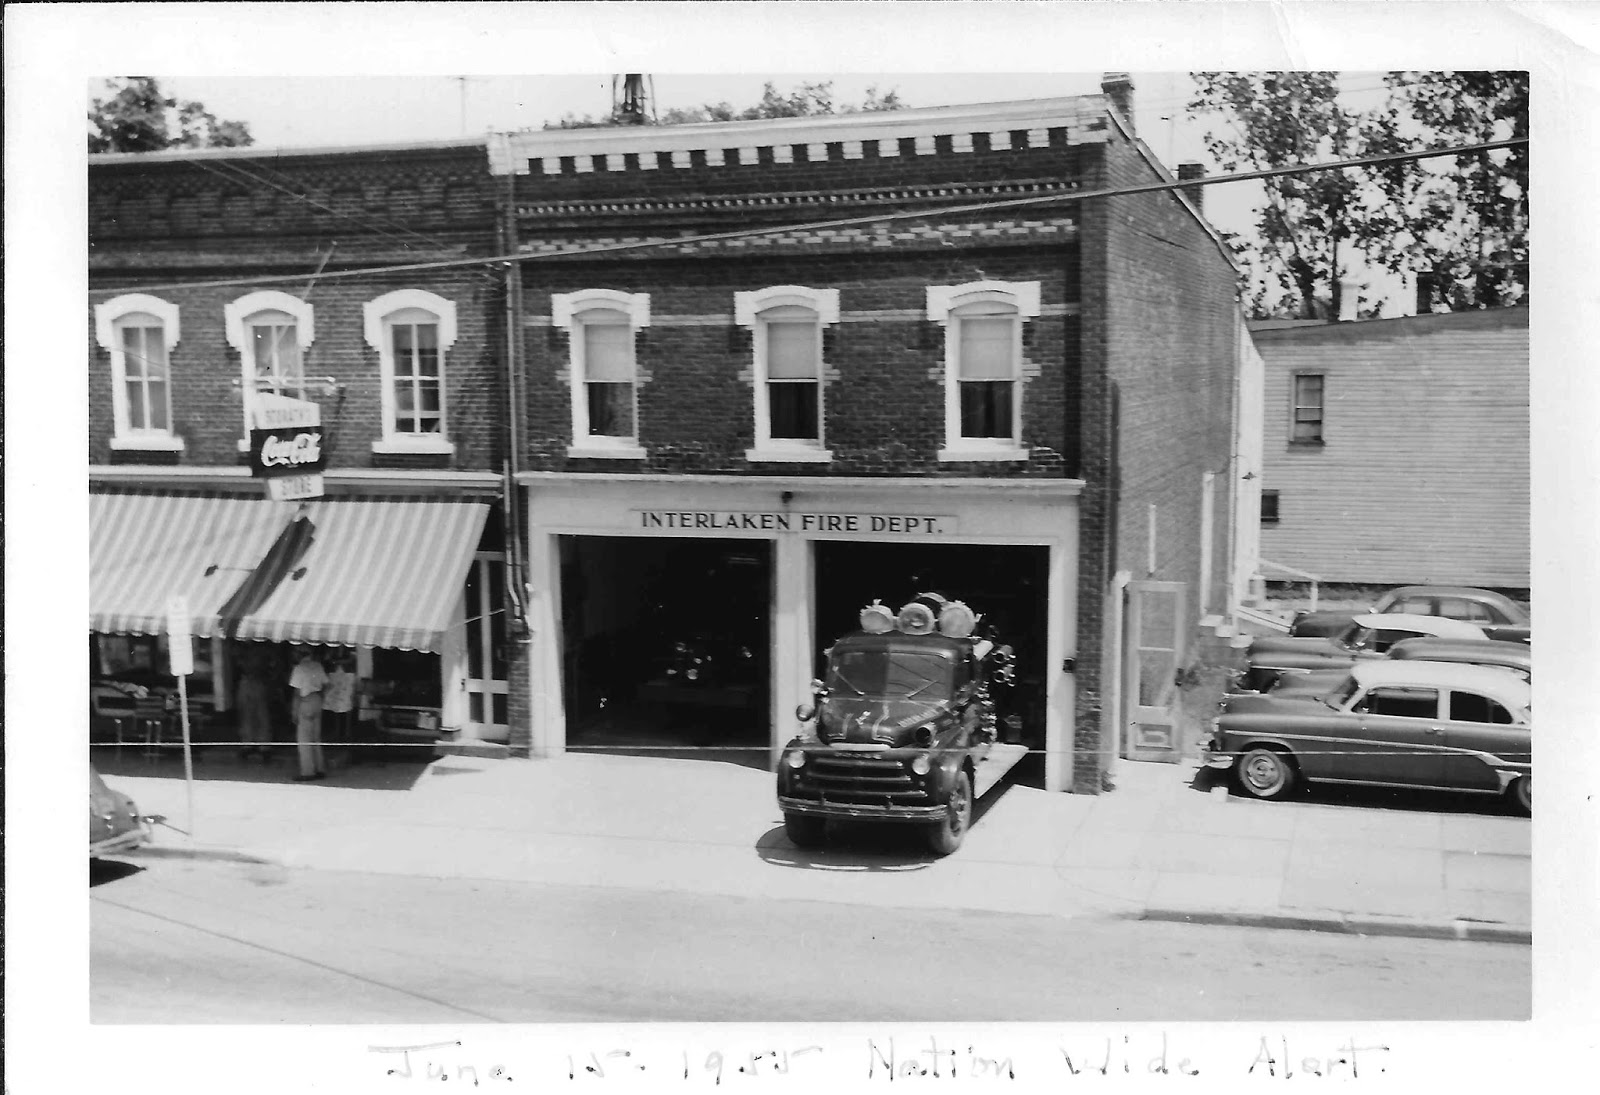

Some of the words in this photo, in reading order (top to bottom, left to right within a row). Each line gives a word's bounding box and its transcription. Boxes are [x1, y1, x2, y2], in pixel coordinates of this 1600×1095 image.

[641, 511, 791, 531] INTERLAKEN
[802, 514, 859, 532] FIRE
[870, 515, 944, 535] DEPT.
[367, 1039, 514, 1087] June
[682, 1045, 823, 1086] 1955
[867, 1034, 1016, 1081] Nation
[1059, 1031, 1200, 1077] Wide
